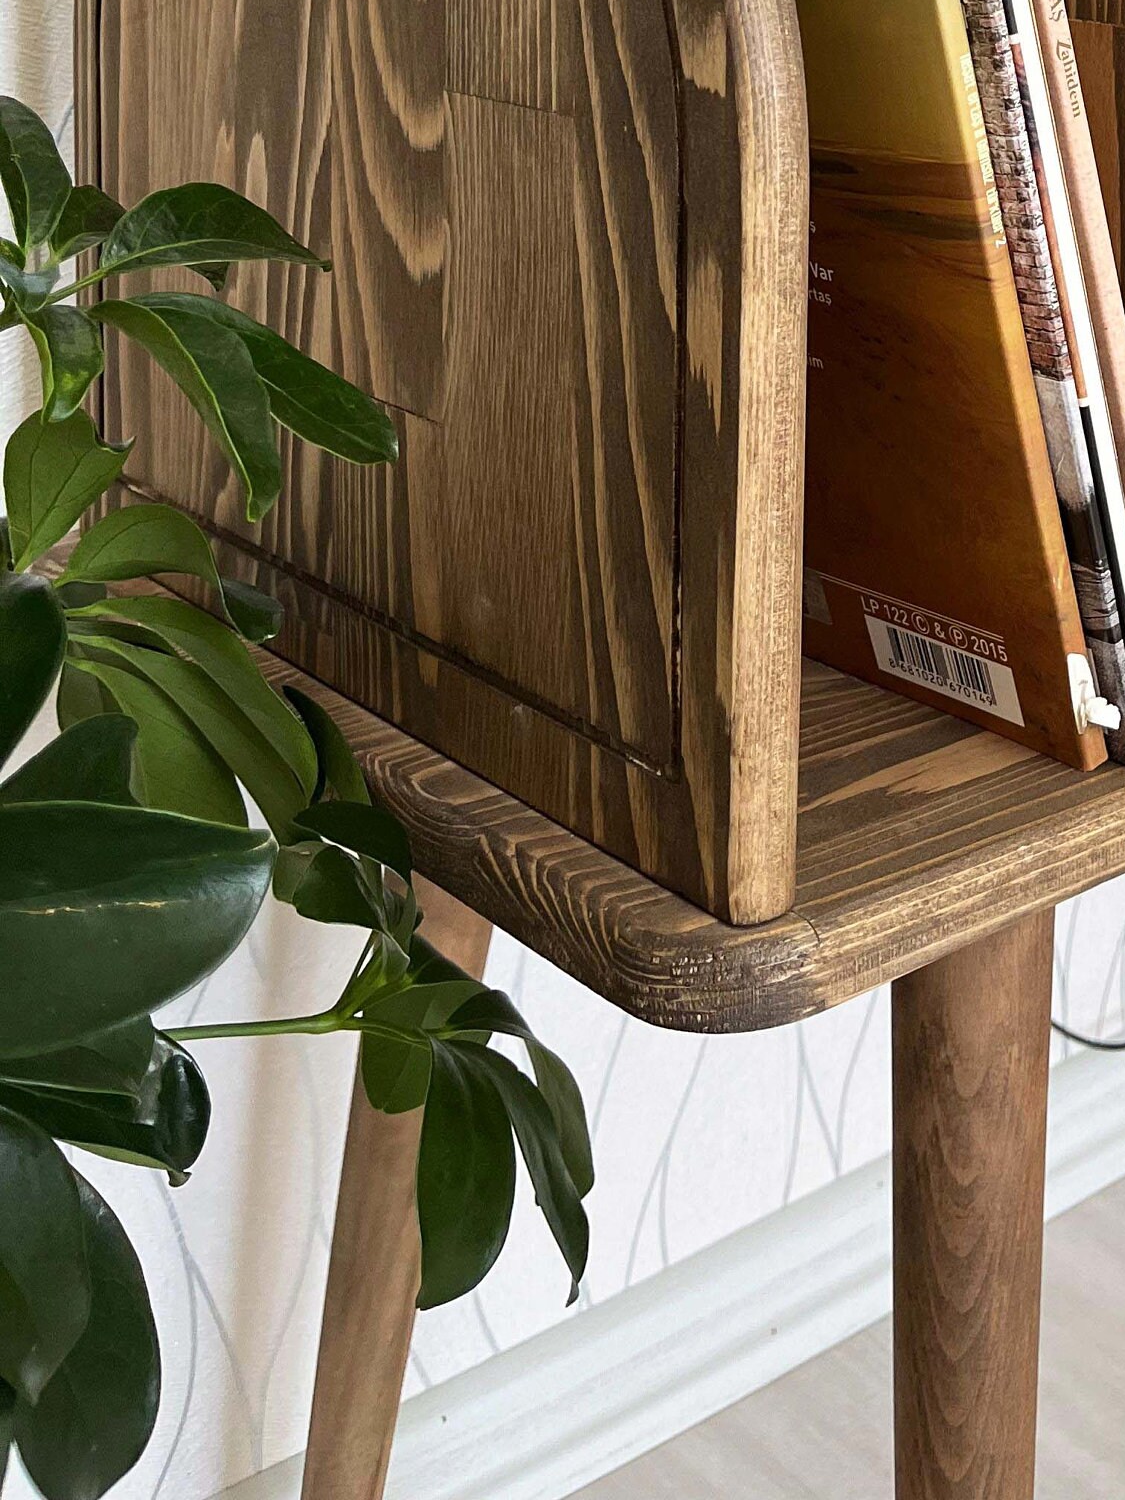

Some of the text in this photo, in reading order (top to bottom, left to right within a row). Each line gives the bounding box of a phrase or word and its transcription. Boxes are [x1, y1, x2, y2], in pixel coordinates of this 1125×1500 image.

[1056, 37, 1082, 119] Zahidem
[808, 289, 832, 305] rtaş
[860, 595, 880, 614] LP
[883, 603, 910, 627] 122
[934, 622, 947, 640] &
[970, 635, 1008, 663] 2015
